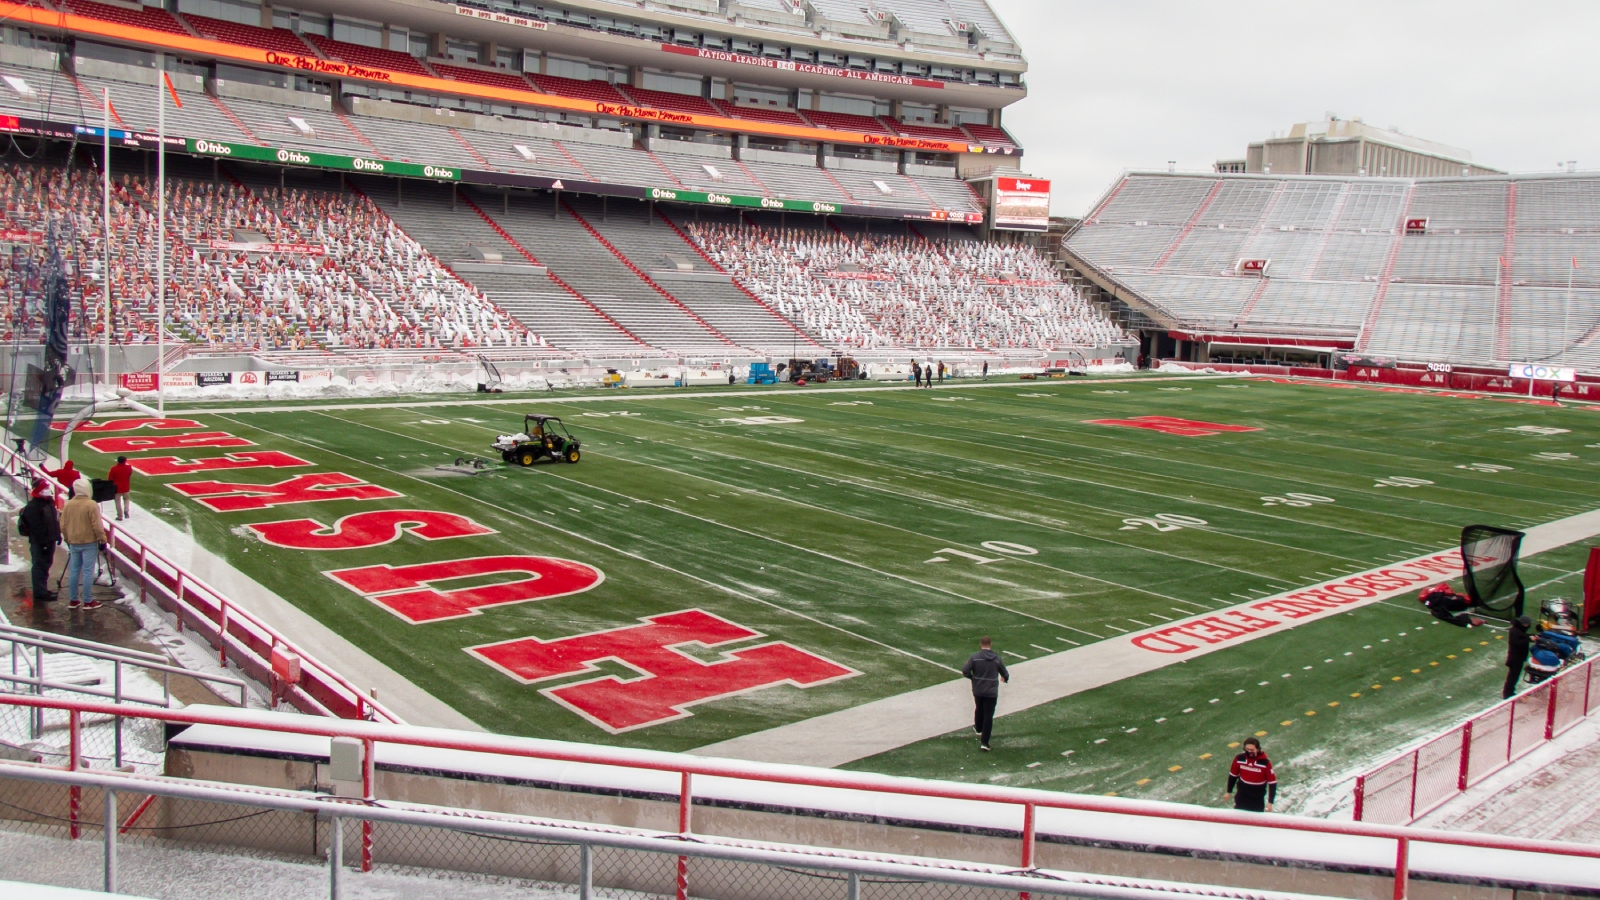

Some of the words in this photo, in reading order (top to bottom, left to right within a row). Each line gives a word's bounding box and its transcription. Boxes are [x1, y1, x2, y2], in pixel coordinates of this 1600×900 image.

[478, 11, 491, 19] 1971
[698, 49, 732, 62] NATION
[736, 54, 773, 67] LEADING
[799, 64, 843, 76] ACADEMIC
[847, 70, 861, 79] ALL
[865, 73, 912, 85] AMERICANS
[209, 143, 231, 155] fnbo
[289, 152, 310, 164] fnbo
[364, 160, 384, 171] fnbo
[434, 168, 453, 178] fnbo
[660, 190, 676, 199] fnbo
[716, 195, 731, 204] fnbo
[769, 200, 784, 208] fnbo
[821, 204, 835, 212] fnbo
[1428, 363, 1451, 372] 90:00
[1370, 369, 1379, 377] N
[1435, 374, 1444, 382] N
[1503, 379, 1512, 388] N
[1578, 385, 1588, 394] N
[1260, 492, 1336, 507] 30
[1122, 513, 1208, 532] 20
[933, 541, 1039, 565] 10
[48, 417, 863, 735] HUSKERS
[1251, 568, 1430, 620] OSBORNE
[1130, 610, 1281, 655] FIELD
